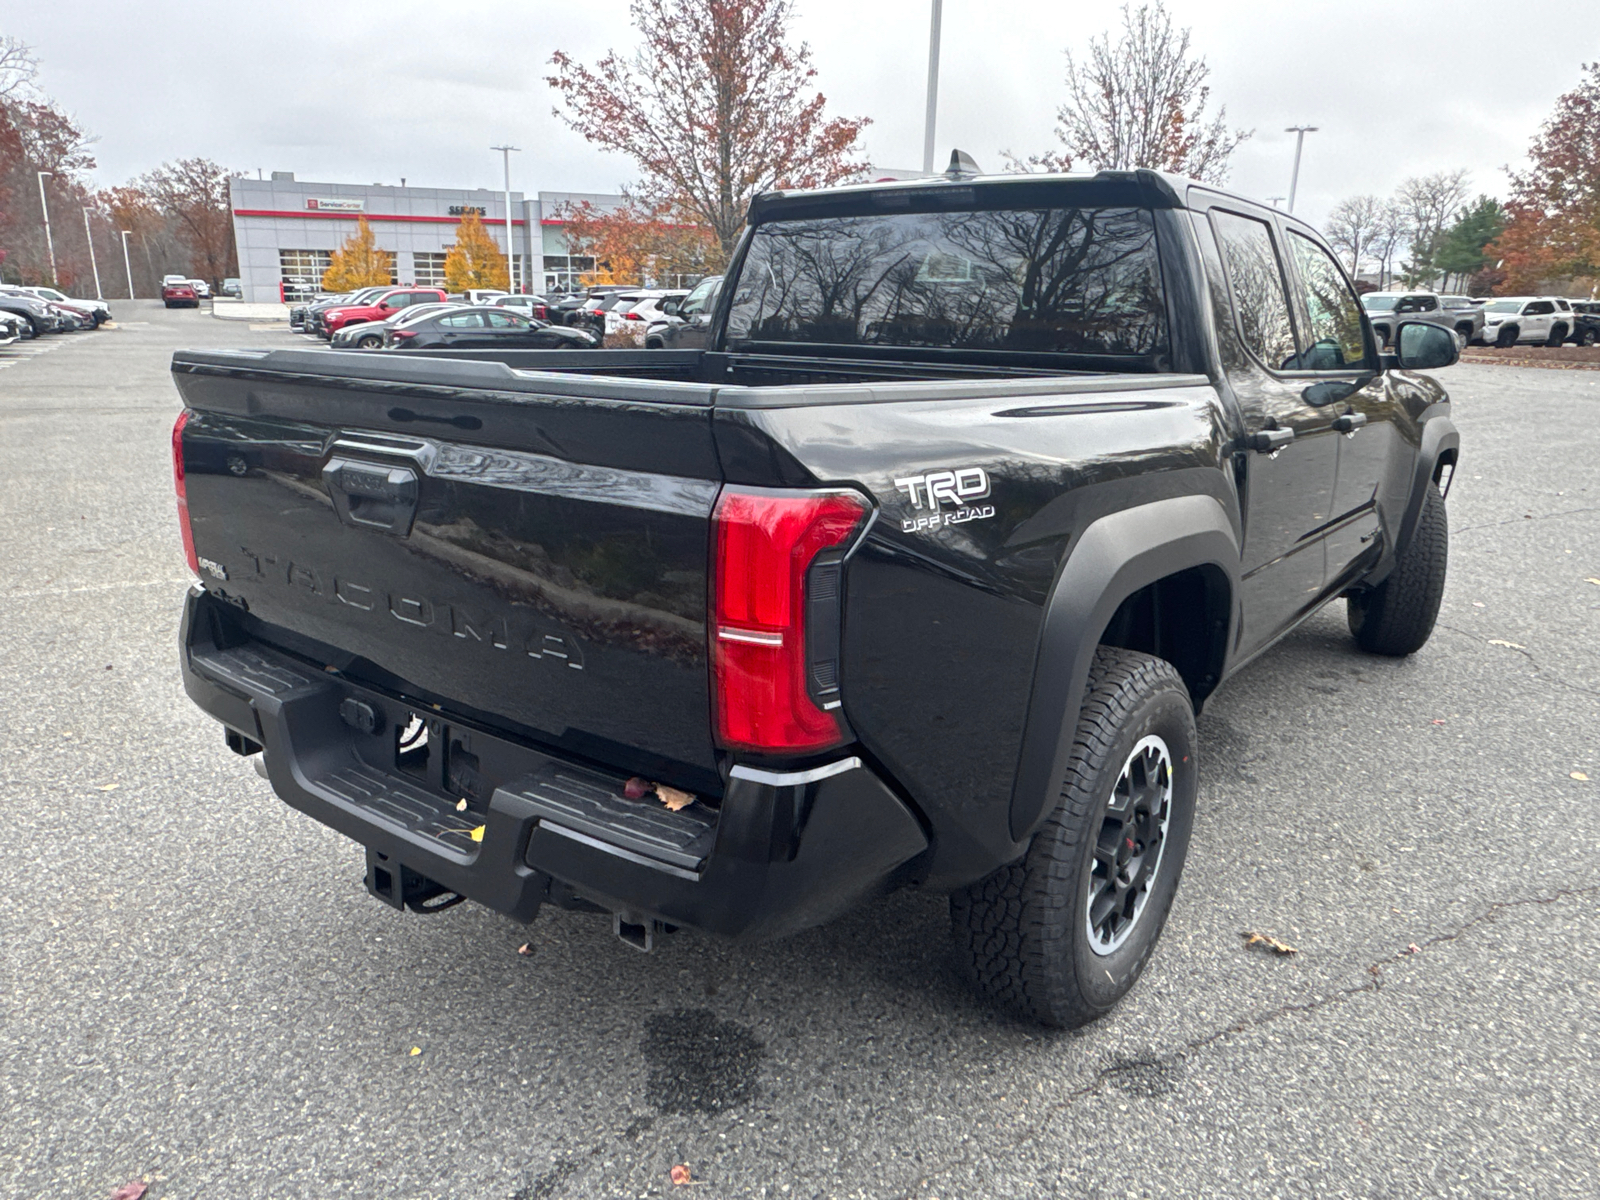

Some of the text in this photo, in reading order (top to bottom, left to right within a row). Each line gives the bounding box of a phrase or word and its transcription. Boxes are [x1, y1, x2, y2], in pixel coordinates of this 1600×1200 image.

[894, 467, 987, 510] TRD
[901, 505, 996, 533] OFF ROAD
[240, 545, 584, 670] TACOMA
